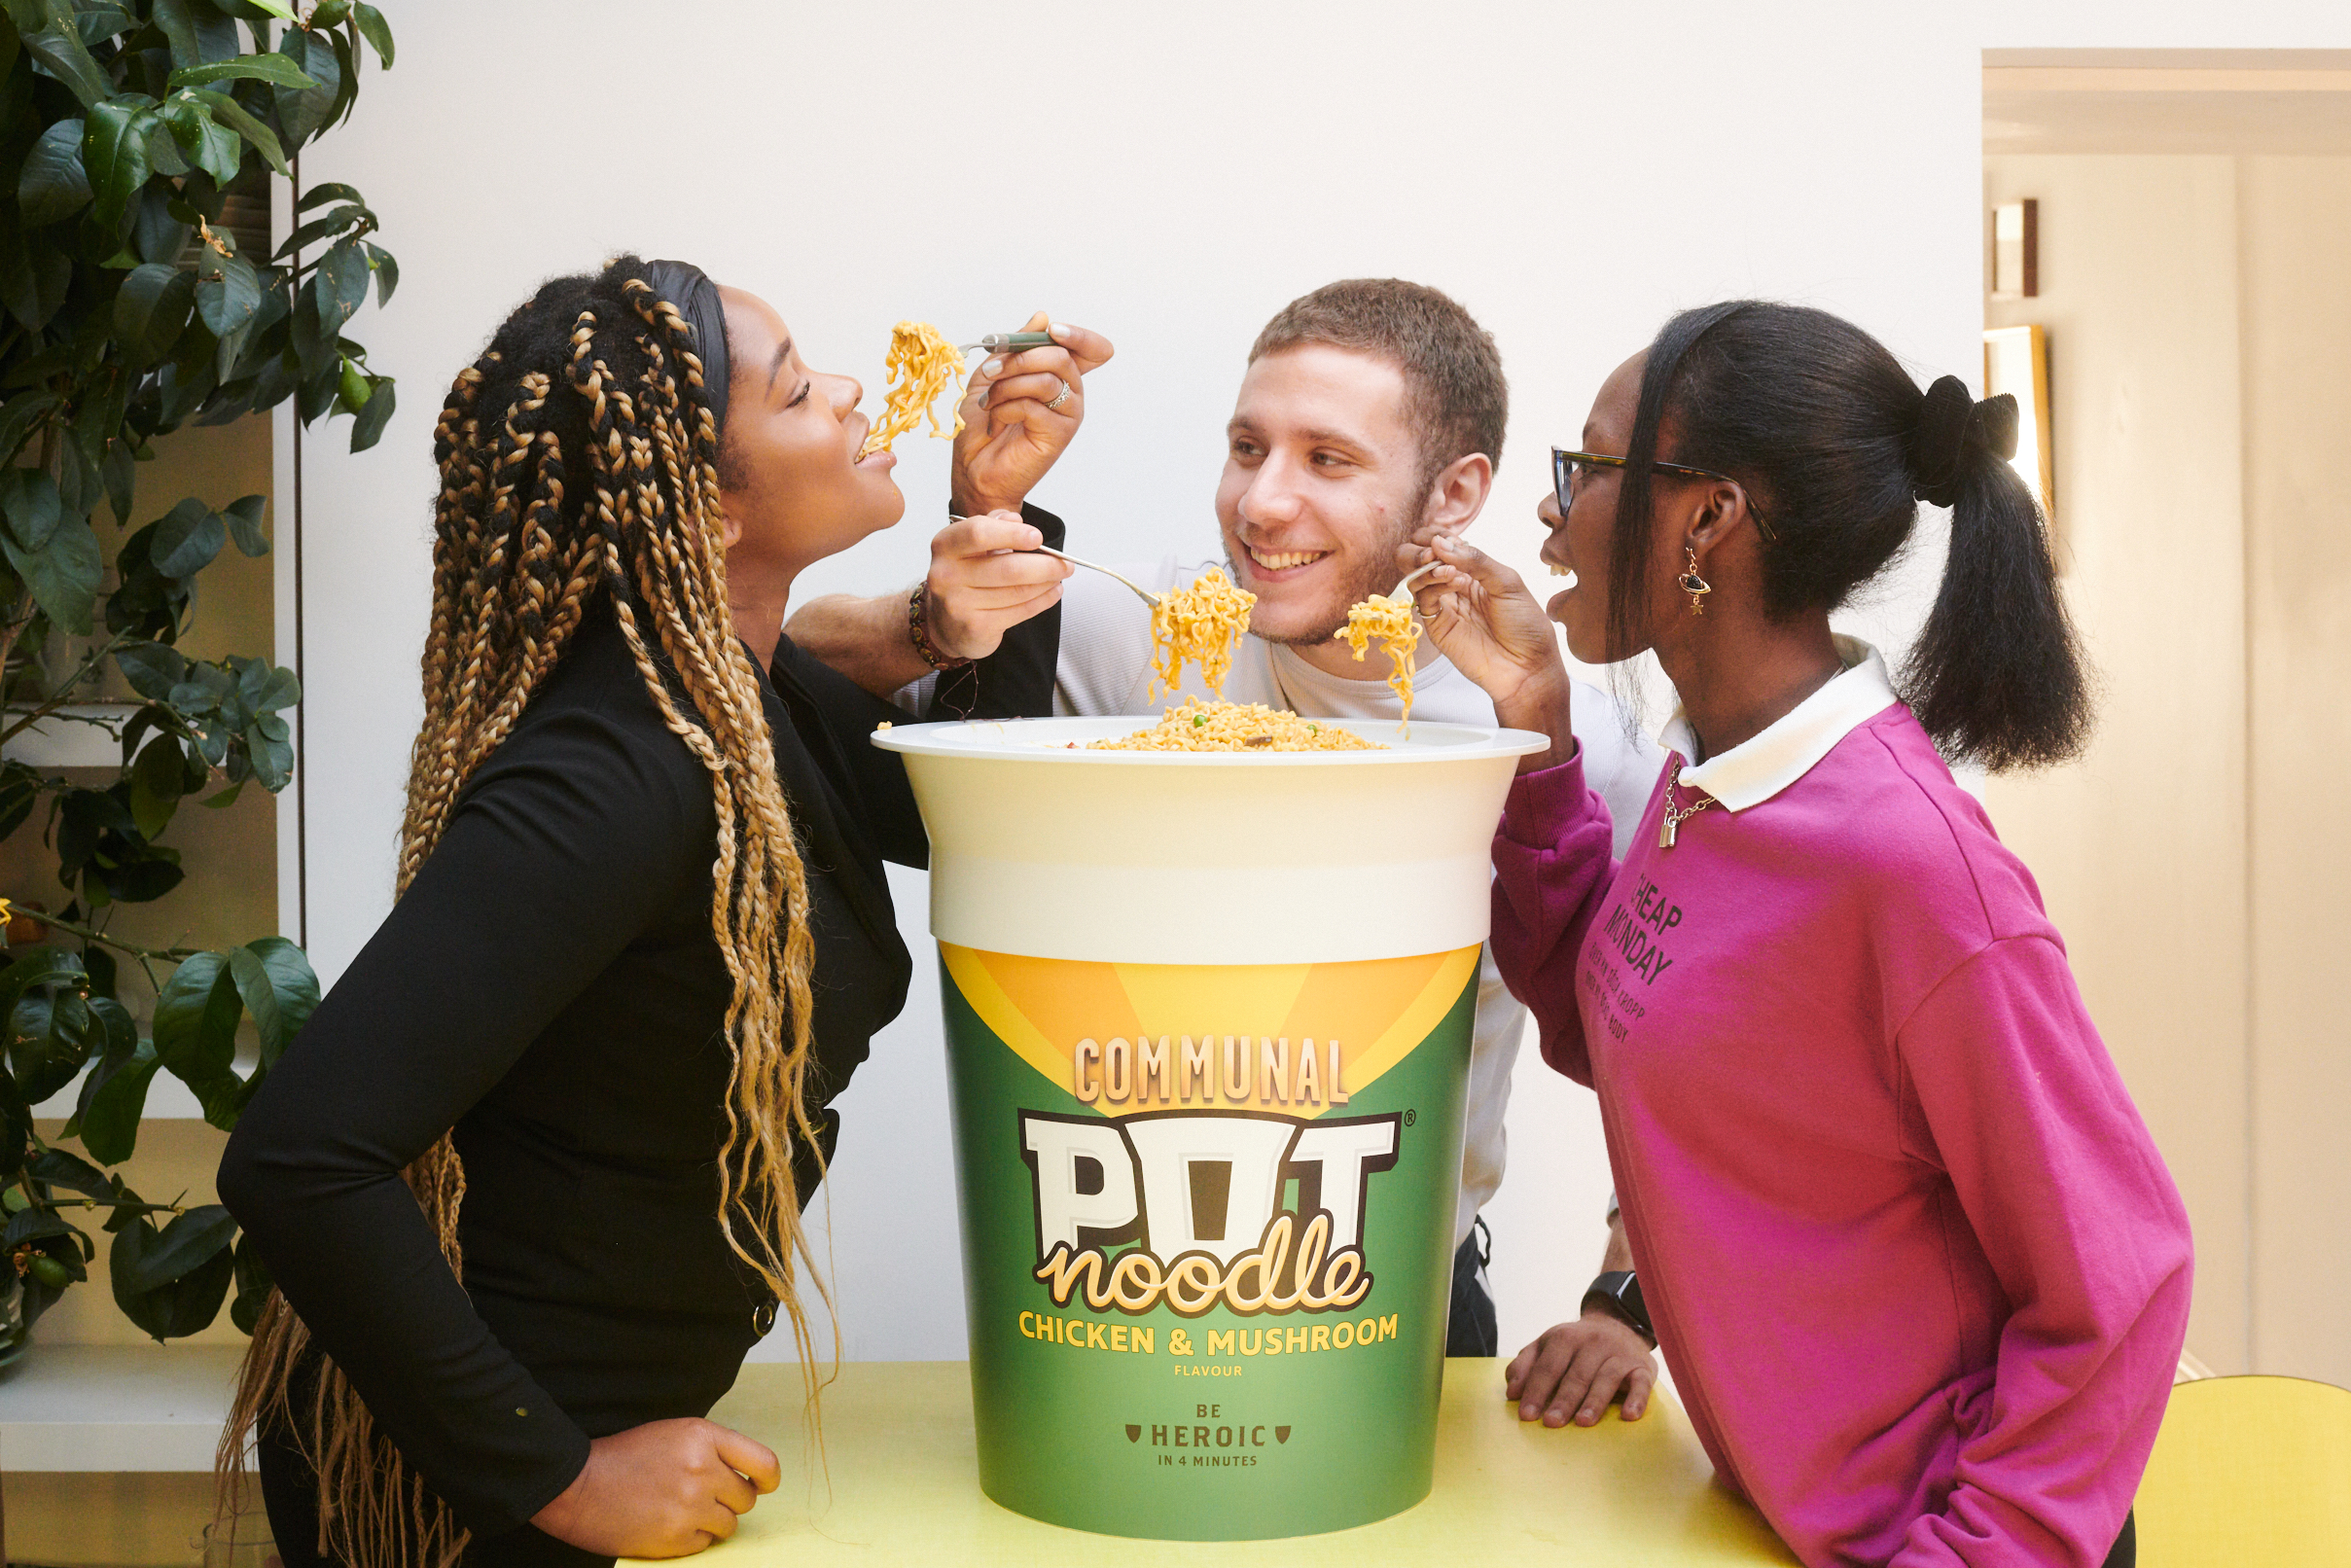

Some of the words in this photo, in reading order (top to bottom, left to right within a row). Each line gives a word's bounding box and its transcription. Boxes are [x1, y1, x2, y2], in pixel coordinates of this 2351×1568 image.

[1603, 904, 1673, 985] MONDAY
[1618, 989, 1646, 1020] KROPP
[1609, 1014, 1628, 1044] BODY
[1074, 1034, 1349, 1106] COMMUNAL
[1018, 1110, 1402, 1268] POT
[1035, 1212, 1371, 1314] noodle
[1018, 1310, 1156, 1355] CHICKEN
[1168, 1328, 1195, 1357] &
[1207, 1313, 1399, 1357] MUSHROOM
[1174, 1365, 1243, 1377] FLAVOUR
[1195, 1404, 1222, 1419] BE
[1151, 1424, 1266, 1447] HEROIC
[1158, 1454, 1173, 1467] IN
[1178, 1455, 1188, 1467] 4
[1193, 1455, 1258, 1467] MINUTES
